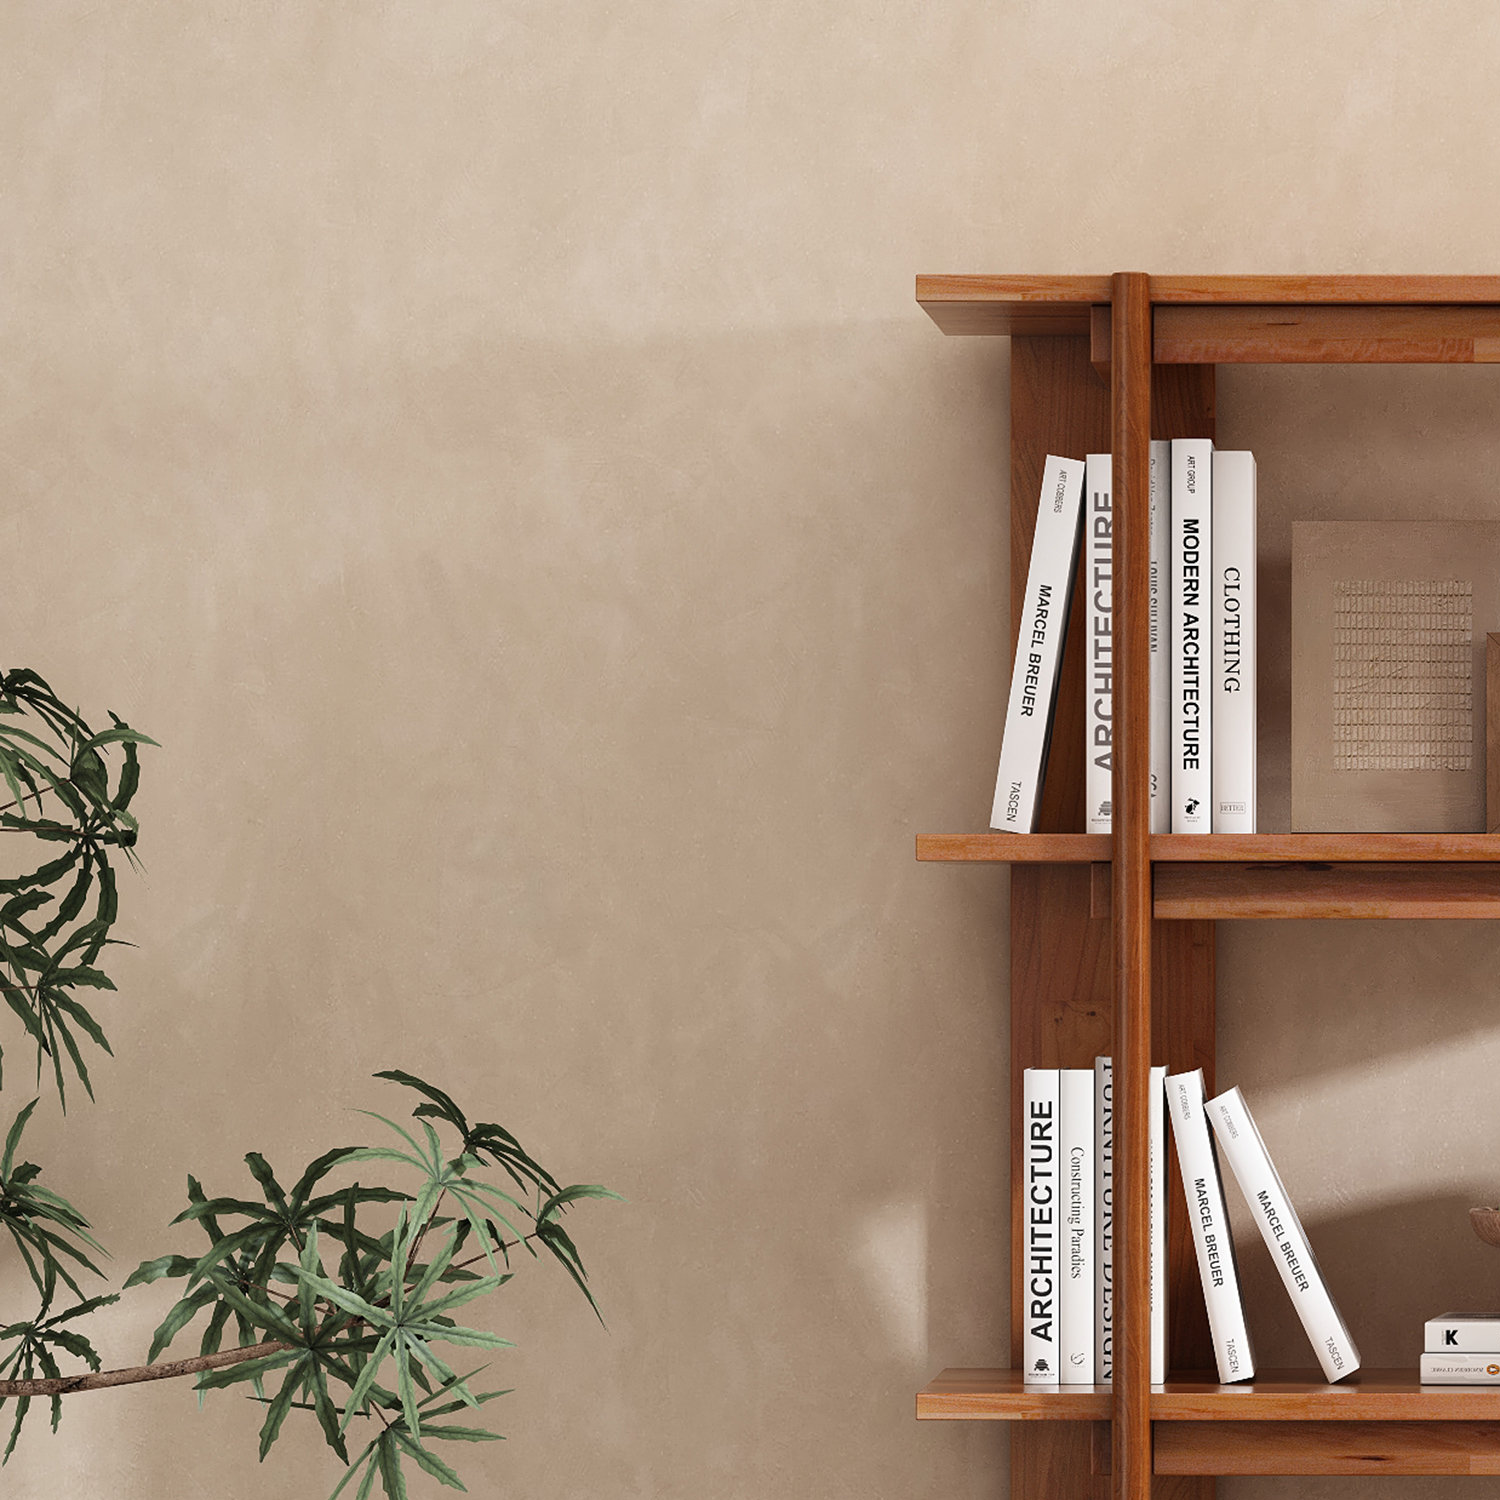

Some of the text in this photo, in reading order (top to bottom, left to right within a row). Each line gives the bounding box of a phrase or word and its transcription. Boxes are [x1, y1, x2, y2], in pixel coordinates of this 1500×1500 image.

[1058, 469, 1067, 483] ART
[1186, 455, 1196, 494] ART GROUP
[1020, 584, 1053, 717] MARCEL BREUER
[1182, 519, 1200, 770] MODERN ARCHITECTURE
[1223, 567, 1241, 693] CLOTHING
[1006, 781, 1022, 822] TASCEN
[1030, 1101, 1053, 1343] ARCHITECTURE
[1067, 1147, 1085, 1279] Constructing Paradies
[1194, 1178, 1224, 1287] MARCEL BREUER
[1257, 1190, 1310, 1292] MARCEL BREUER
[1226, 1338, 1240, 1373] TASCEN
[1324, 1336, 1345, 1370] TASCEN
